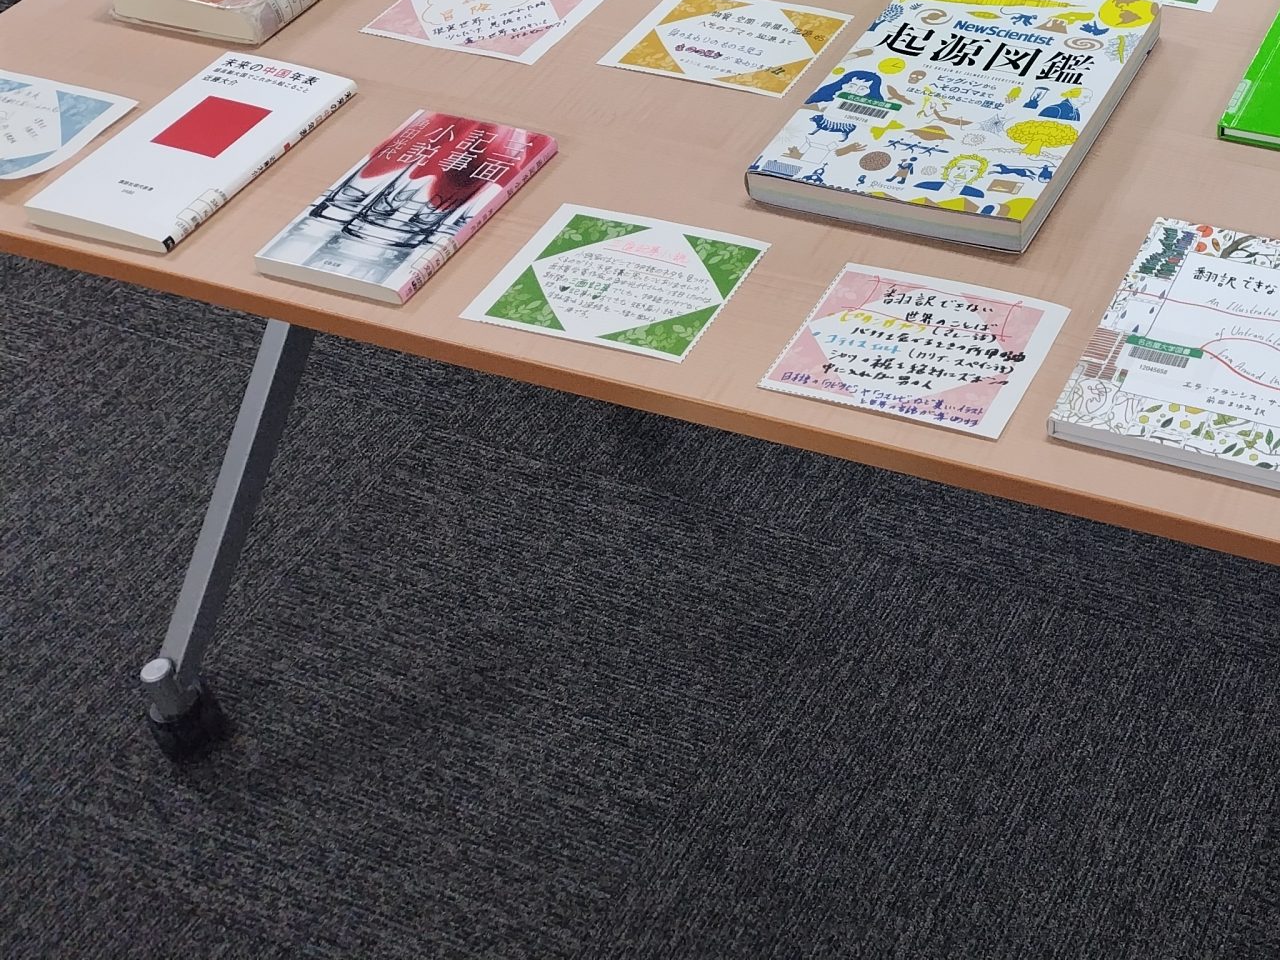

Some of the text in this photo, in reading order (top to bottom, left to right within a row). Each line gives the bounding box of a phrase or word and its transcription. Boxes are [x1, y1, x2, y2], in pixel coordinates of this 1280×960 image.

[875, 21, 1096, 86] 起源図鑑
[222, 57, 321, 87] 未来の中国年表
[937, 73, 997, 91] ビッグバンから
[929, 81, 994, 99] へそのゴマまで
